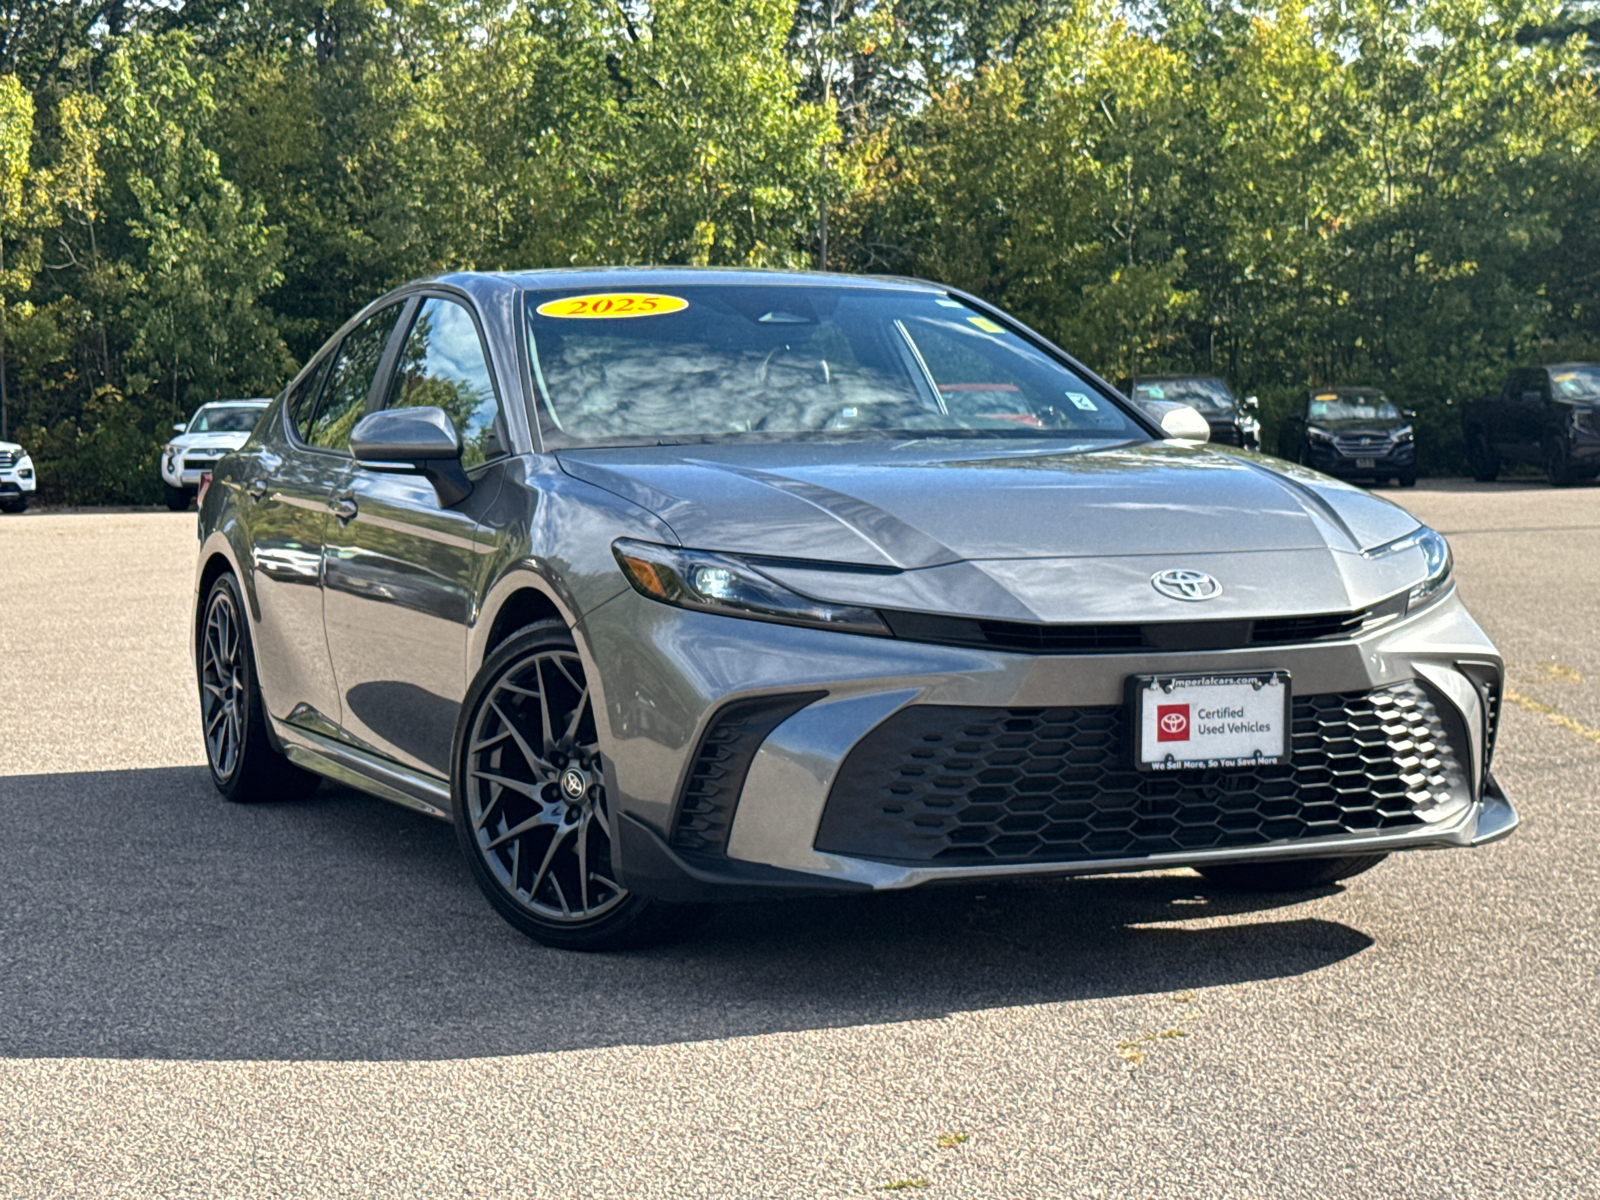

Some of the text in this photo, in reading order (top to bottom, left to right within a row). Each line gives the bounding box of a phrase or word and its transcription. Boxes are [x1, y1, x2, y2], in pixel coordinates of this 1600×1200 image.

[567, 298, 660, 315] 2025
[1171, 677, 1258, 688] Imperialcars.com
[1197, 707, 1244, 719] Certified
[1198, 721, 1271, 735] Used Vehicles
[1152, 757, 1277, 770] We Sell More, So You Save More
